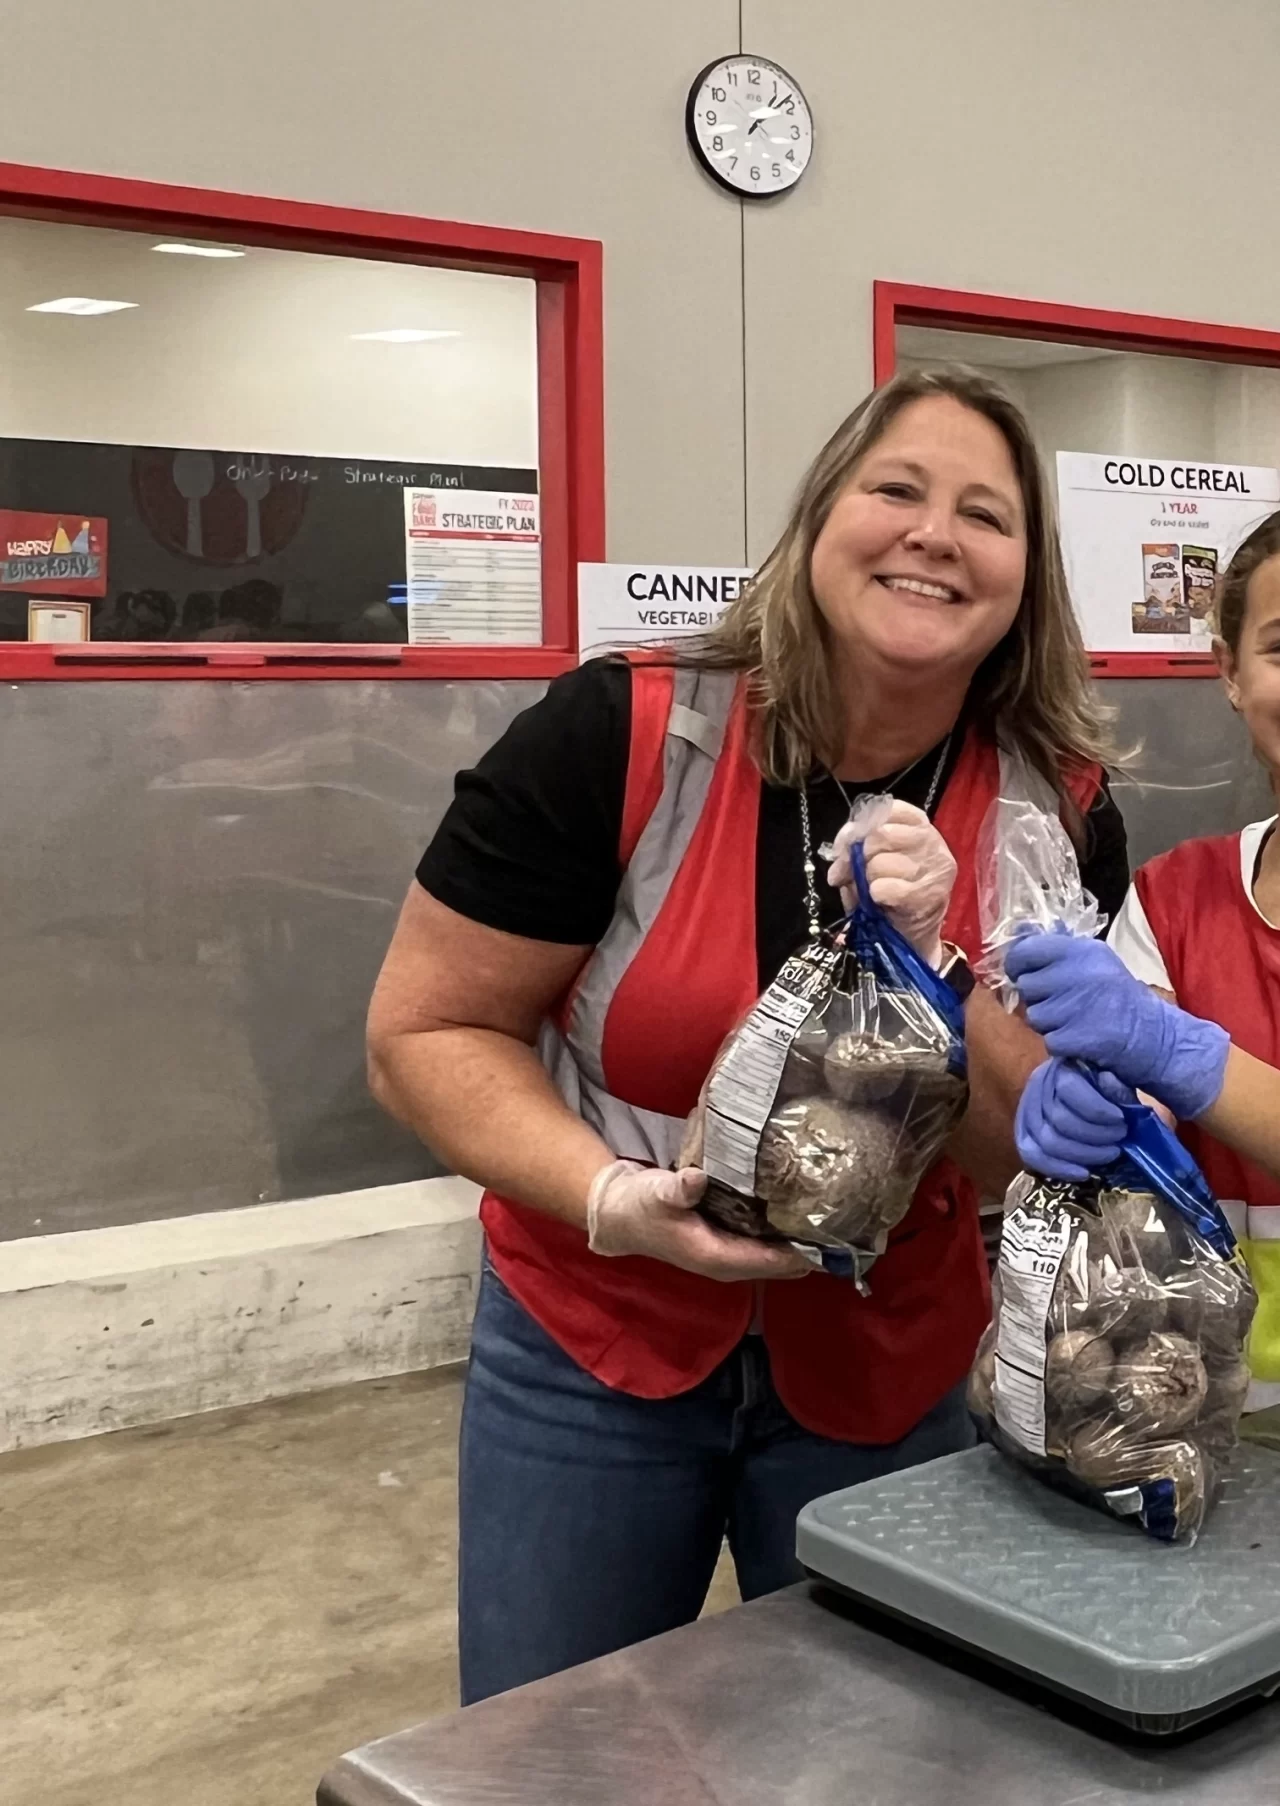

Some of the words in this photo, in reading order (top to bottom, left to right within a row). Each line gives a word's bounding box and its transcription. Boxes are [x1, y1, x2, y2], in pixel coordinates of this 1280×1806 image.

[727, 72, 738, 87] 11
[747, 69, 761, 86] 12
[711, 87, 727, 102] 10
[773, 80, 778, 95] 1
[785, 99, 796, 116] 2
[706, 110, 717, 126] 9
[790, 125, 801, 140] 3
[712, 135, 724, 152] 8
[785, 148, 796, 162] 4
[728, 155, 738, 171] 7
[771, 163, 781, 178] 5
[750, 166, 761, 181] 6
[1105, 461, 1165, 488] COLD
[1170, 466, 1251, 494] CEREAL
[1169, 502, 1199, 515] YEAR
[506, 516, 536, 532] PLAN
[7, 540, 53, 556] HAPPY
